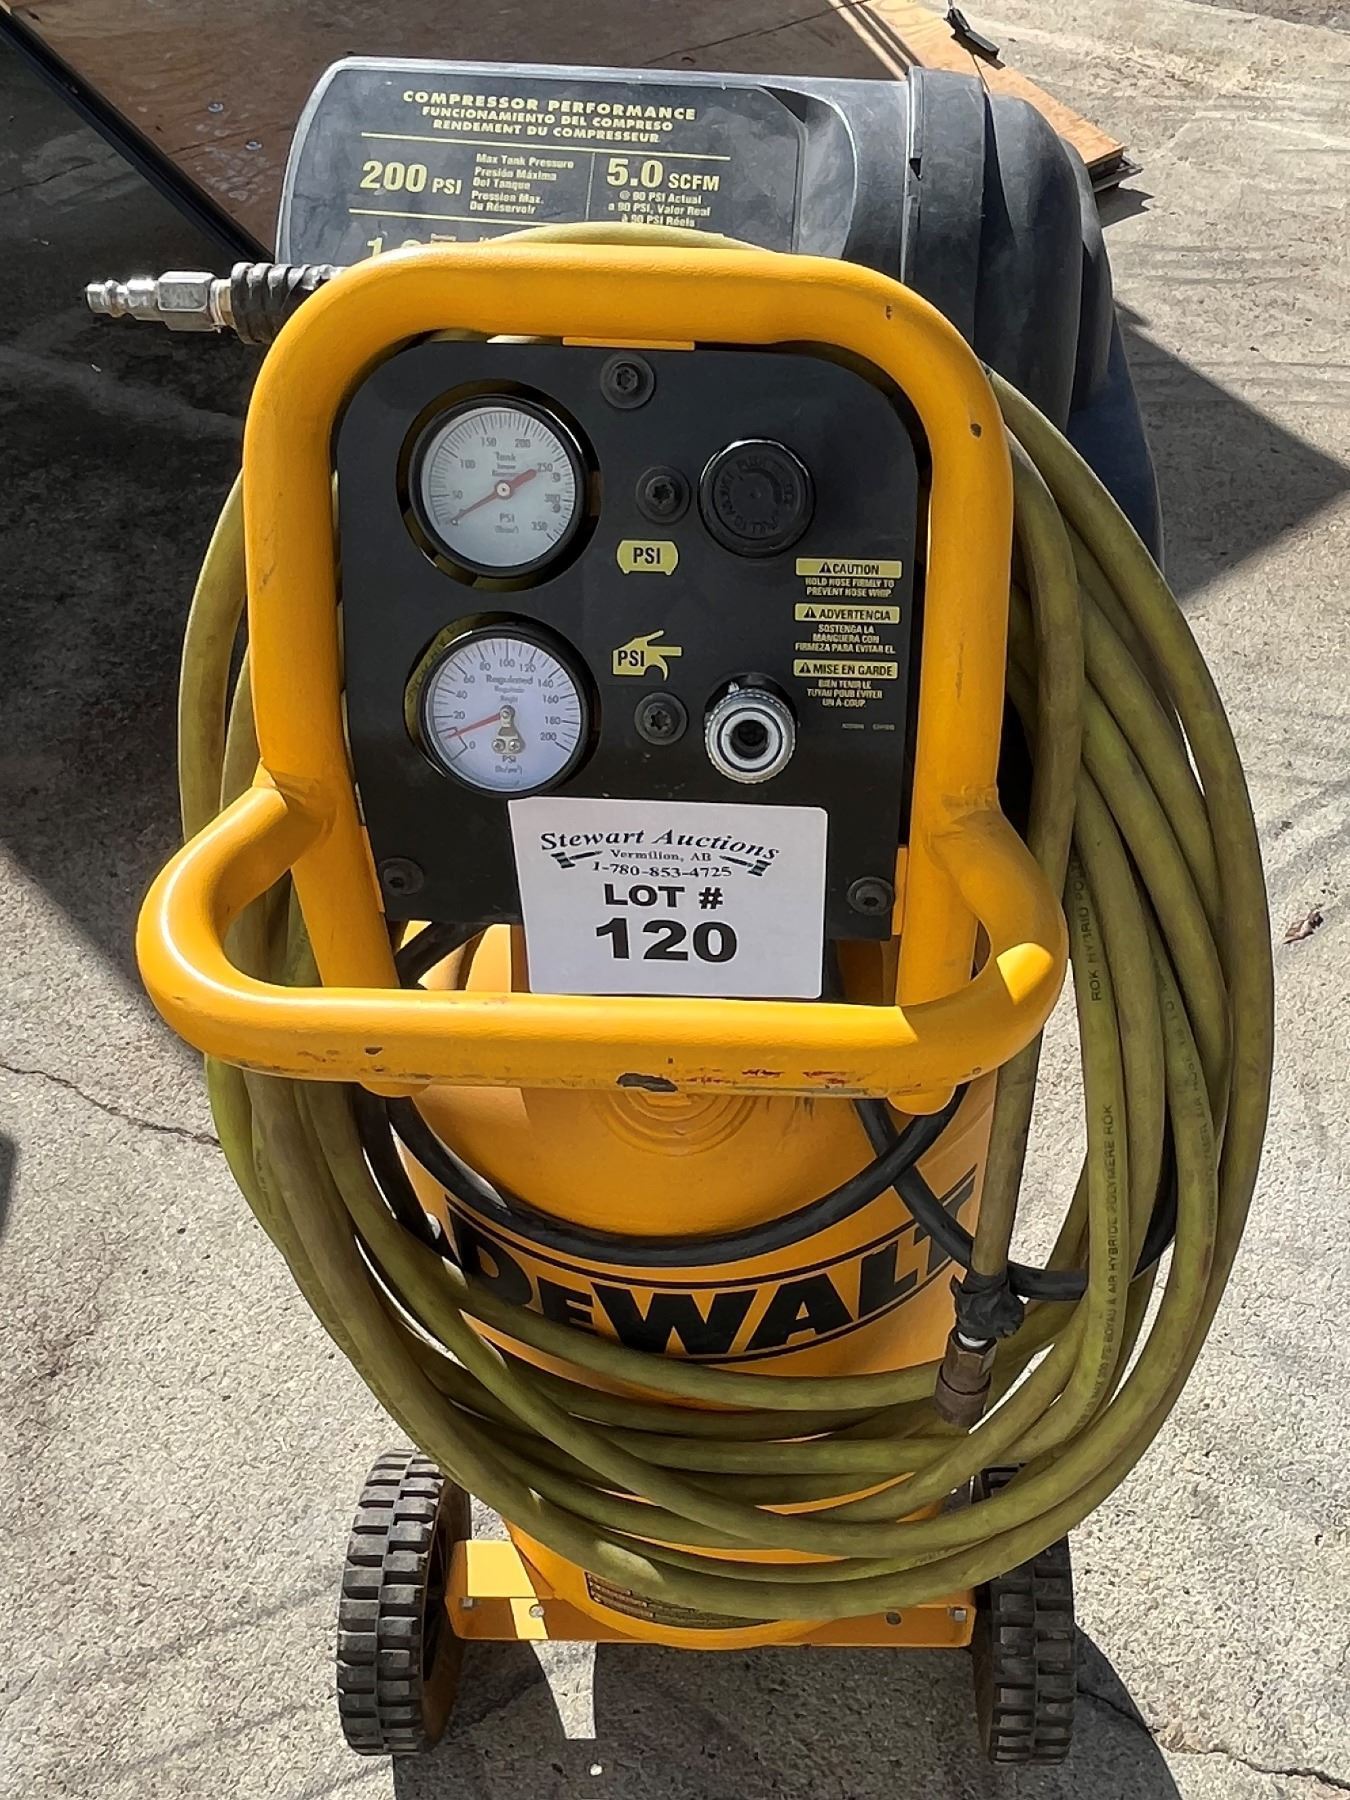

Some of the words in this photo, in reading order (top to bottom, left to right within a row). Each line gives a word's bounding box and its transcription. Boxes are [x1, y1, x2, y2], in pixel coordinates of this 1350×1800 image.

[403, 91, 538, 111] COMPRESSOR
[548, 100, 697, 121] PERFORMANCE
[422, 106, 556, 124] FUNCIONAMIENTO
[561, 114, 587, 126] DEL
[592, 117, 674, 132] COMPRESO
[433, 119, 521, 135] RENDEMENT
[527, 125, 548, 136] DU
[553, 126, 661, 143] COMPRESSEUR
[476, 153, 497, 164] Max
[501, 155, 526, 166] Tank
[528, 157, 574, 169] Pressure
[360, 160, 428, 193] 200
[431, 177, 462, 195] PSI
[607, 157, 664, 188] 5.0
[668, 172, 720, 192] SCFM
[648, 192, 666, 203] PSI
[667, 193, 702, 205] Actual
[657, 204, 686, 216] Valor
[687, 206, 711, 217] Real
[646, 215, 664, 225] PSI
[481, 437, 497, 447] 150
[452, 490, 463, 499] 50
[499, 513, 515, 523] PSI
[633, 547, 661, 565] PSI
[832, 563, 880, 575] CAUTION
[805, 577, 828, 586] HOLD
[829, 578, 851, 587] HOSE
[883, 580, 895, 588] TO
[806, 586, 844, 596] PREVENT
[845, 588, 868, 597] HOSE
[819, 609, 891, 620] ADVERTENCIA
[818, 624, 862, 633] SOSTENGA
[863, 625, 875, 634] LA
[812, 633, 860, 643] MANGUERA
[831, 643, 854, 652] PARA
[499, 658, 515, 668] 100
[617, 650, 645, 667] PSI
[479, 662, 491, 672] 80
[519, 663, 536, 673] 120
[812, 664, 839, 675] MISE
[841, 665, 855, 675] EN
[858, 665, 893, 676] GARDE
[464, 674, 475, 684] 60
[538, 678, 554, 688] 140
[456, 690, 468, 700] 40
[543, 695, 560, 704] 160
[453, 711, 465, 720] 20
[544, 716, 561, 725] 180
[540, 732, 557, 742] 200
[468, 741, 476, 750] 0
[540, 829, 645, 851] Stewart
[652, 829, 780, 860] Auctions
[690, 851, 712, 862] AB
[592, 863, 732, 878] 1-780-853-4725
[604, 883, 685, 908] LOT
[698, 887, 724, 909] #
[596, 917, 737, 963] 120
[1103, 1104, 1114, 1136] ROK
[1108, 1274, 1118, 1294] AIR
